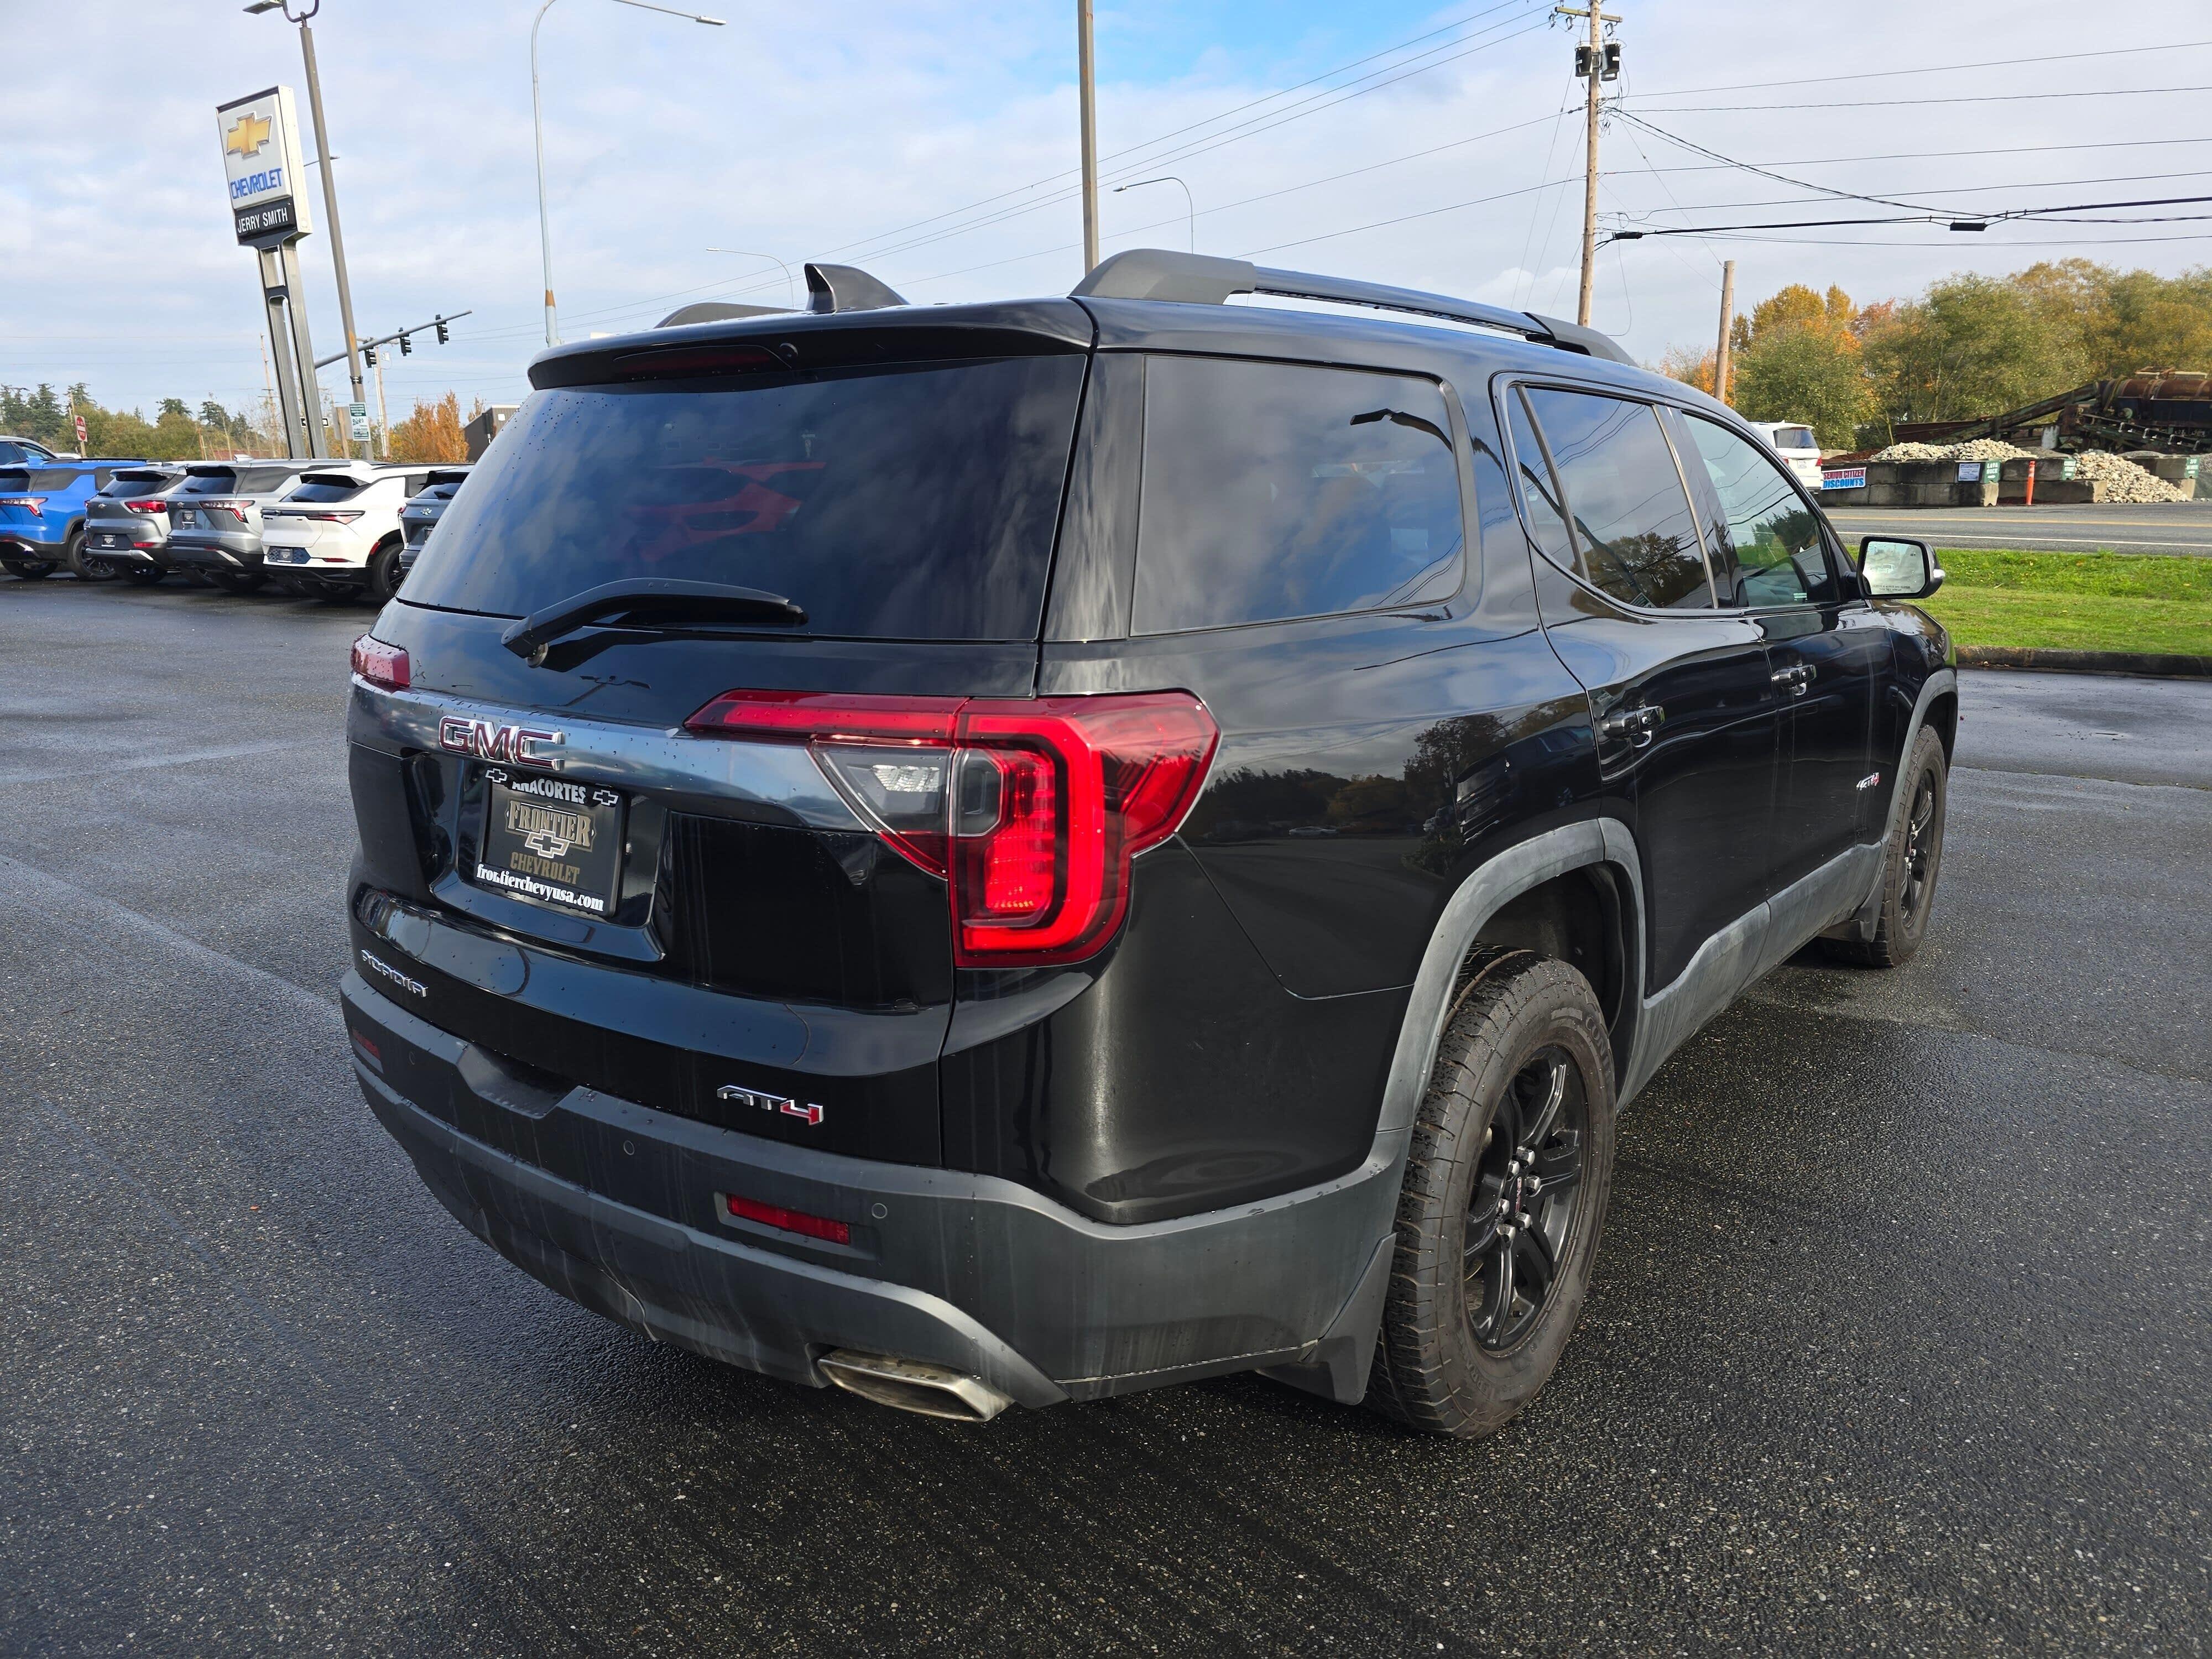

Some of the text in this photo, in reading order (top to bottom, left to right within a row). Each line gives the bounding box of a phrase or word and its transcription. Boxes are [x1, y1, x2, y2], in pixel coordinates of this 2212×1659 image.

[230, 168, 282, 199] CHEVROLET
[238, 207, 288, 233] JERRY SMITH
[1823, 478, 1864, 488] DISCOUNTS
[439, 716, 565, 771] GMC
[508, 800, 592, 847] FRONTIER
[476, 863, 604, 912] frontierchevyusa.com
[509, 851, 581, 885] CHEVROLET
[361, 949, 429, 998] ACADIA
[717, 1084, 824, 1126] AT4
